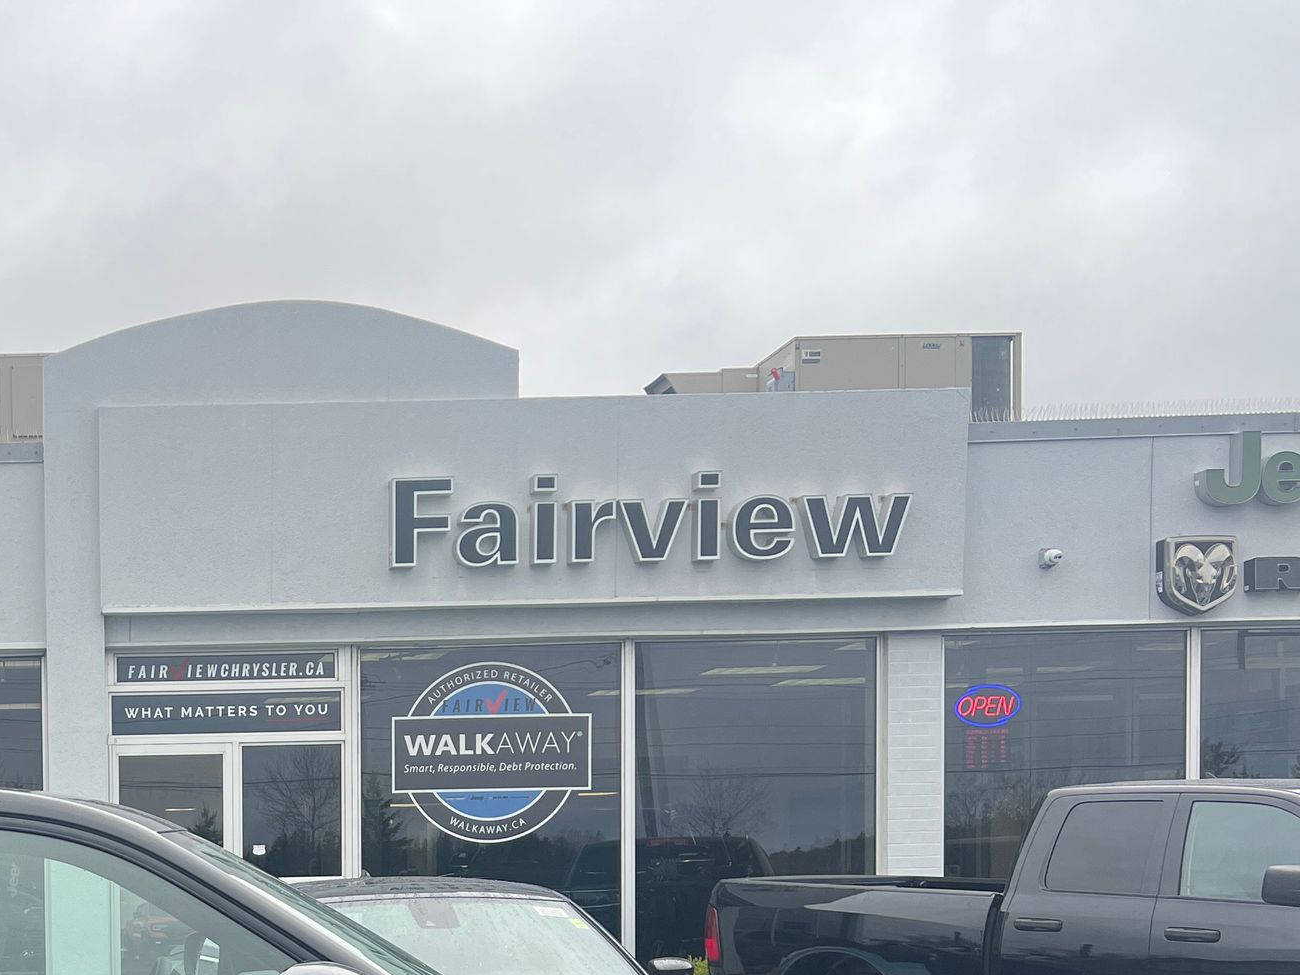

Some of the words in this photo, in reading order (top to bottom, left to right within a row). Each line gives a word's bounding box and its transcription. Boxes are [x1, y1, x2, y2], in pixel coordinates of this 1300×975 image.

[389, 470, 914, 569] Fairview
[427, 669, 499, 705] AUTHORIZED
[503, 672, 554, 703] RETAILER
[124, 706, 174, 719] WHAT
[181, 705, 258, 719] MATTERS
[265, 704, 287, 717] TO
[294, 703, 329, 716] YOU
[957, 695, 1015, 717] OPEN
[403, 731, 577, 756] WALKAWAY
[404, 763, 436, 774] Smart,
[437, 762, 497, 774] Responsible,
[499, 761, 522, 772] Debt
[524, 761, 577, 772] Protection.
[449, 816, 528, 835] WALKAWAY.CA
